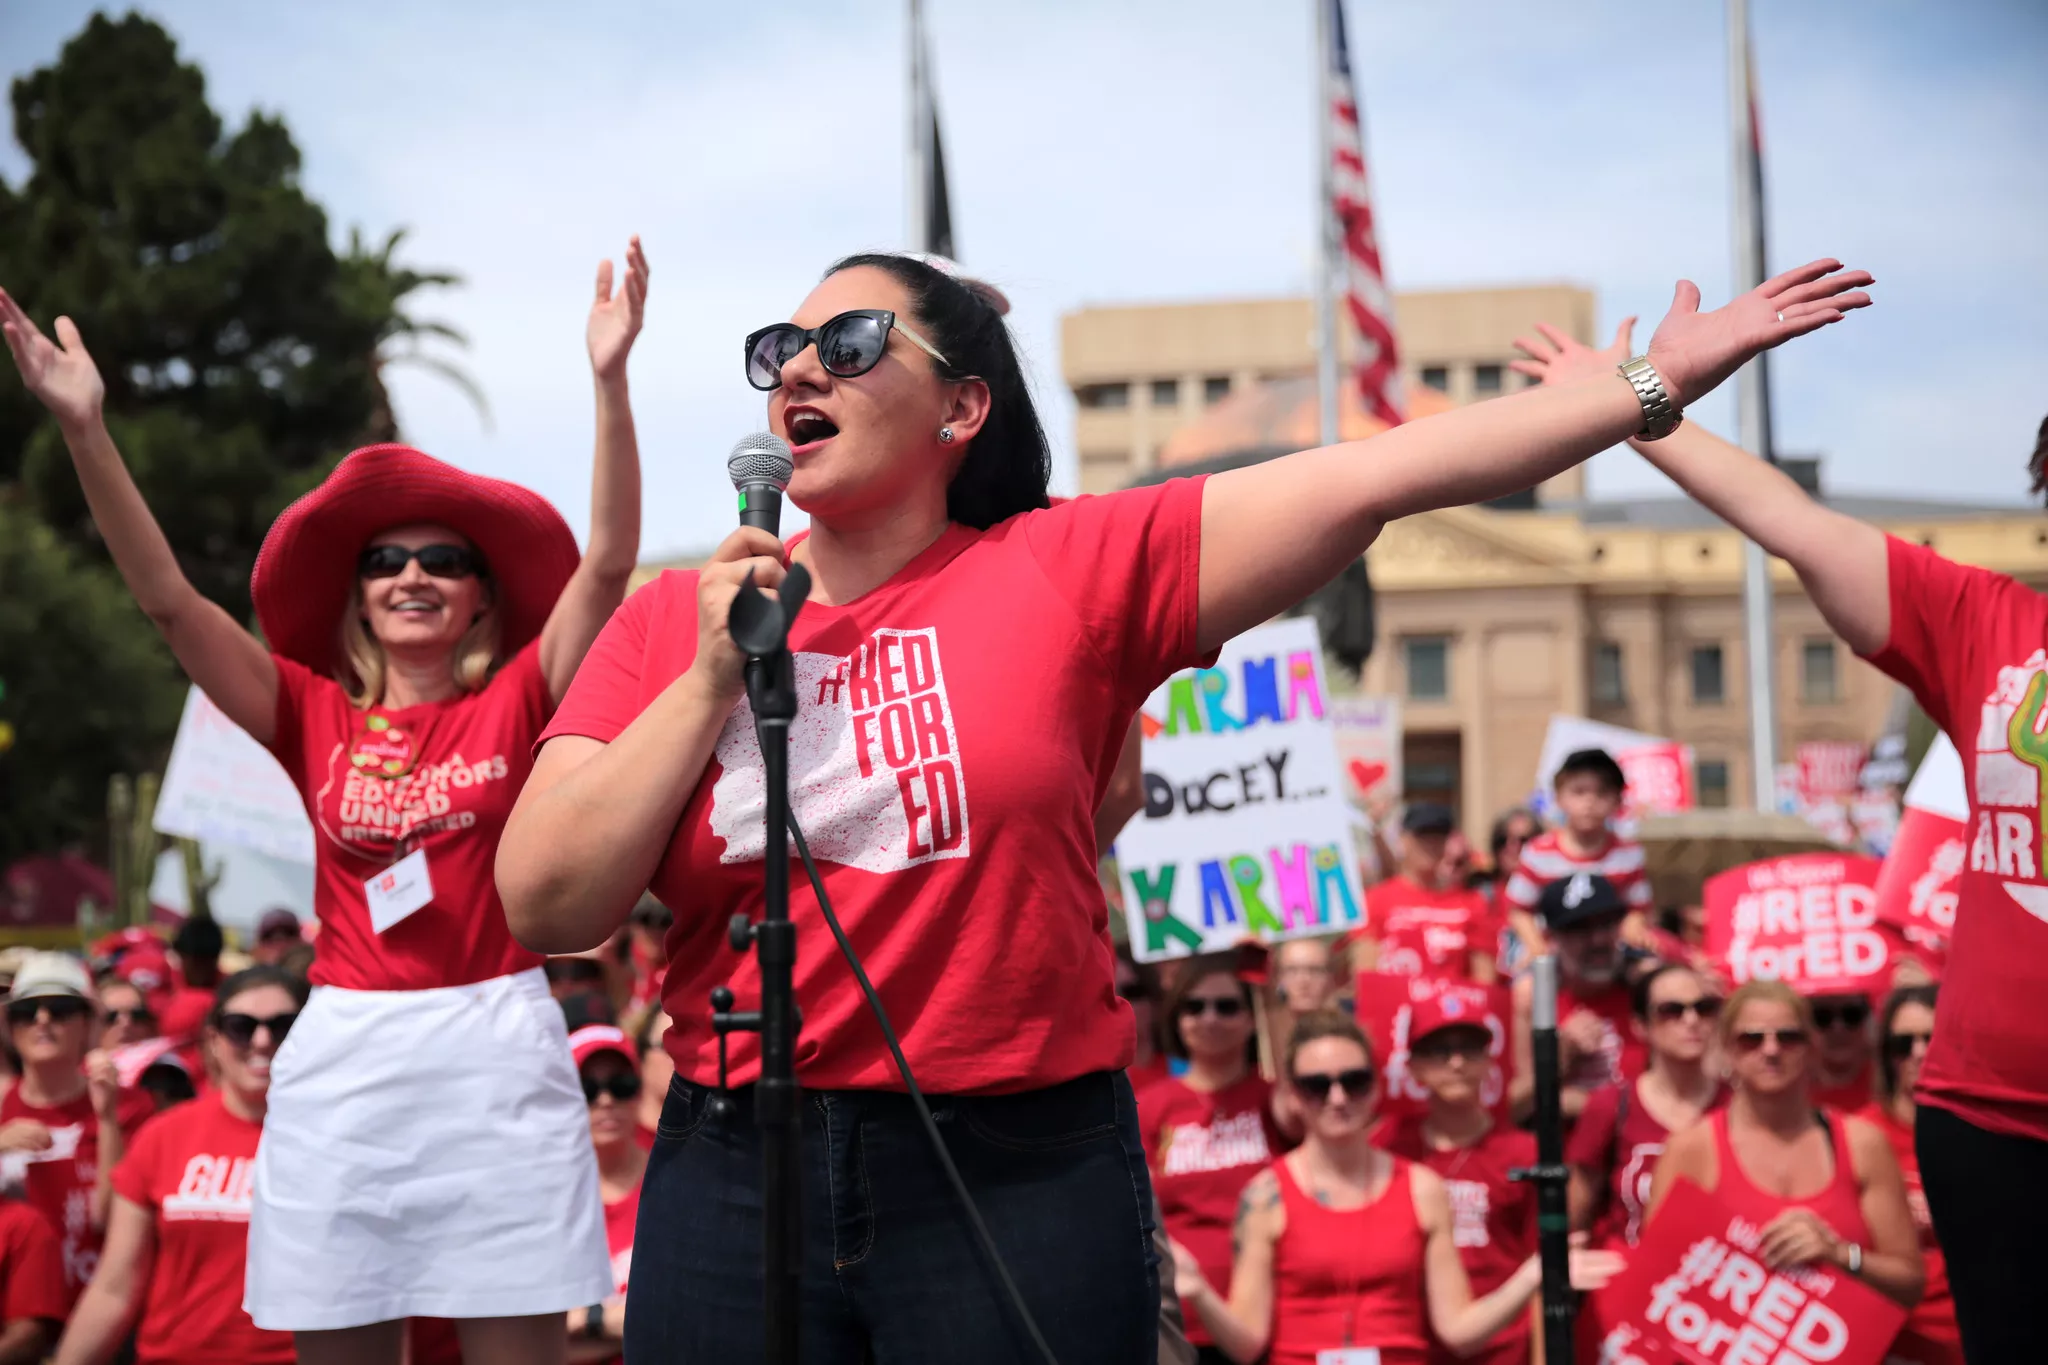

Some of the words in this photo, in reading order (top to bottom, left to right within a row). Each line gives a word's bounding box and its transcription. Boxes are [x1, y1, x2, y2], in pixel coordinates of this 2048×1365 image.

[816, 634, 937, 712] #RED
[1141, 650, 1325, 740] ARMA
[852, 691, 950, 779] FOR
[896, 759, 963, 860] ED
[1130, 842, 1360, 953] KARMA
[1731, 883, 1878, 936] #RED
[1726, 930, 1888, 984] forED
[1645, 1273, 1812, 1365] forE
[1680, 1236, 1849, 1362] #RED
